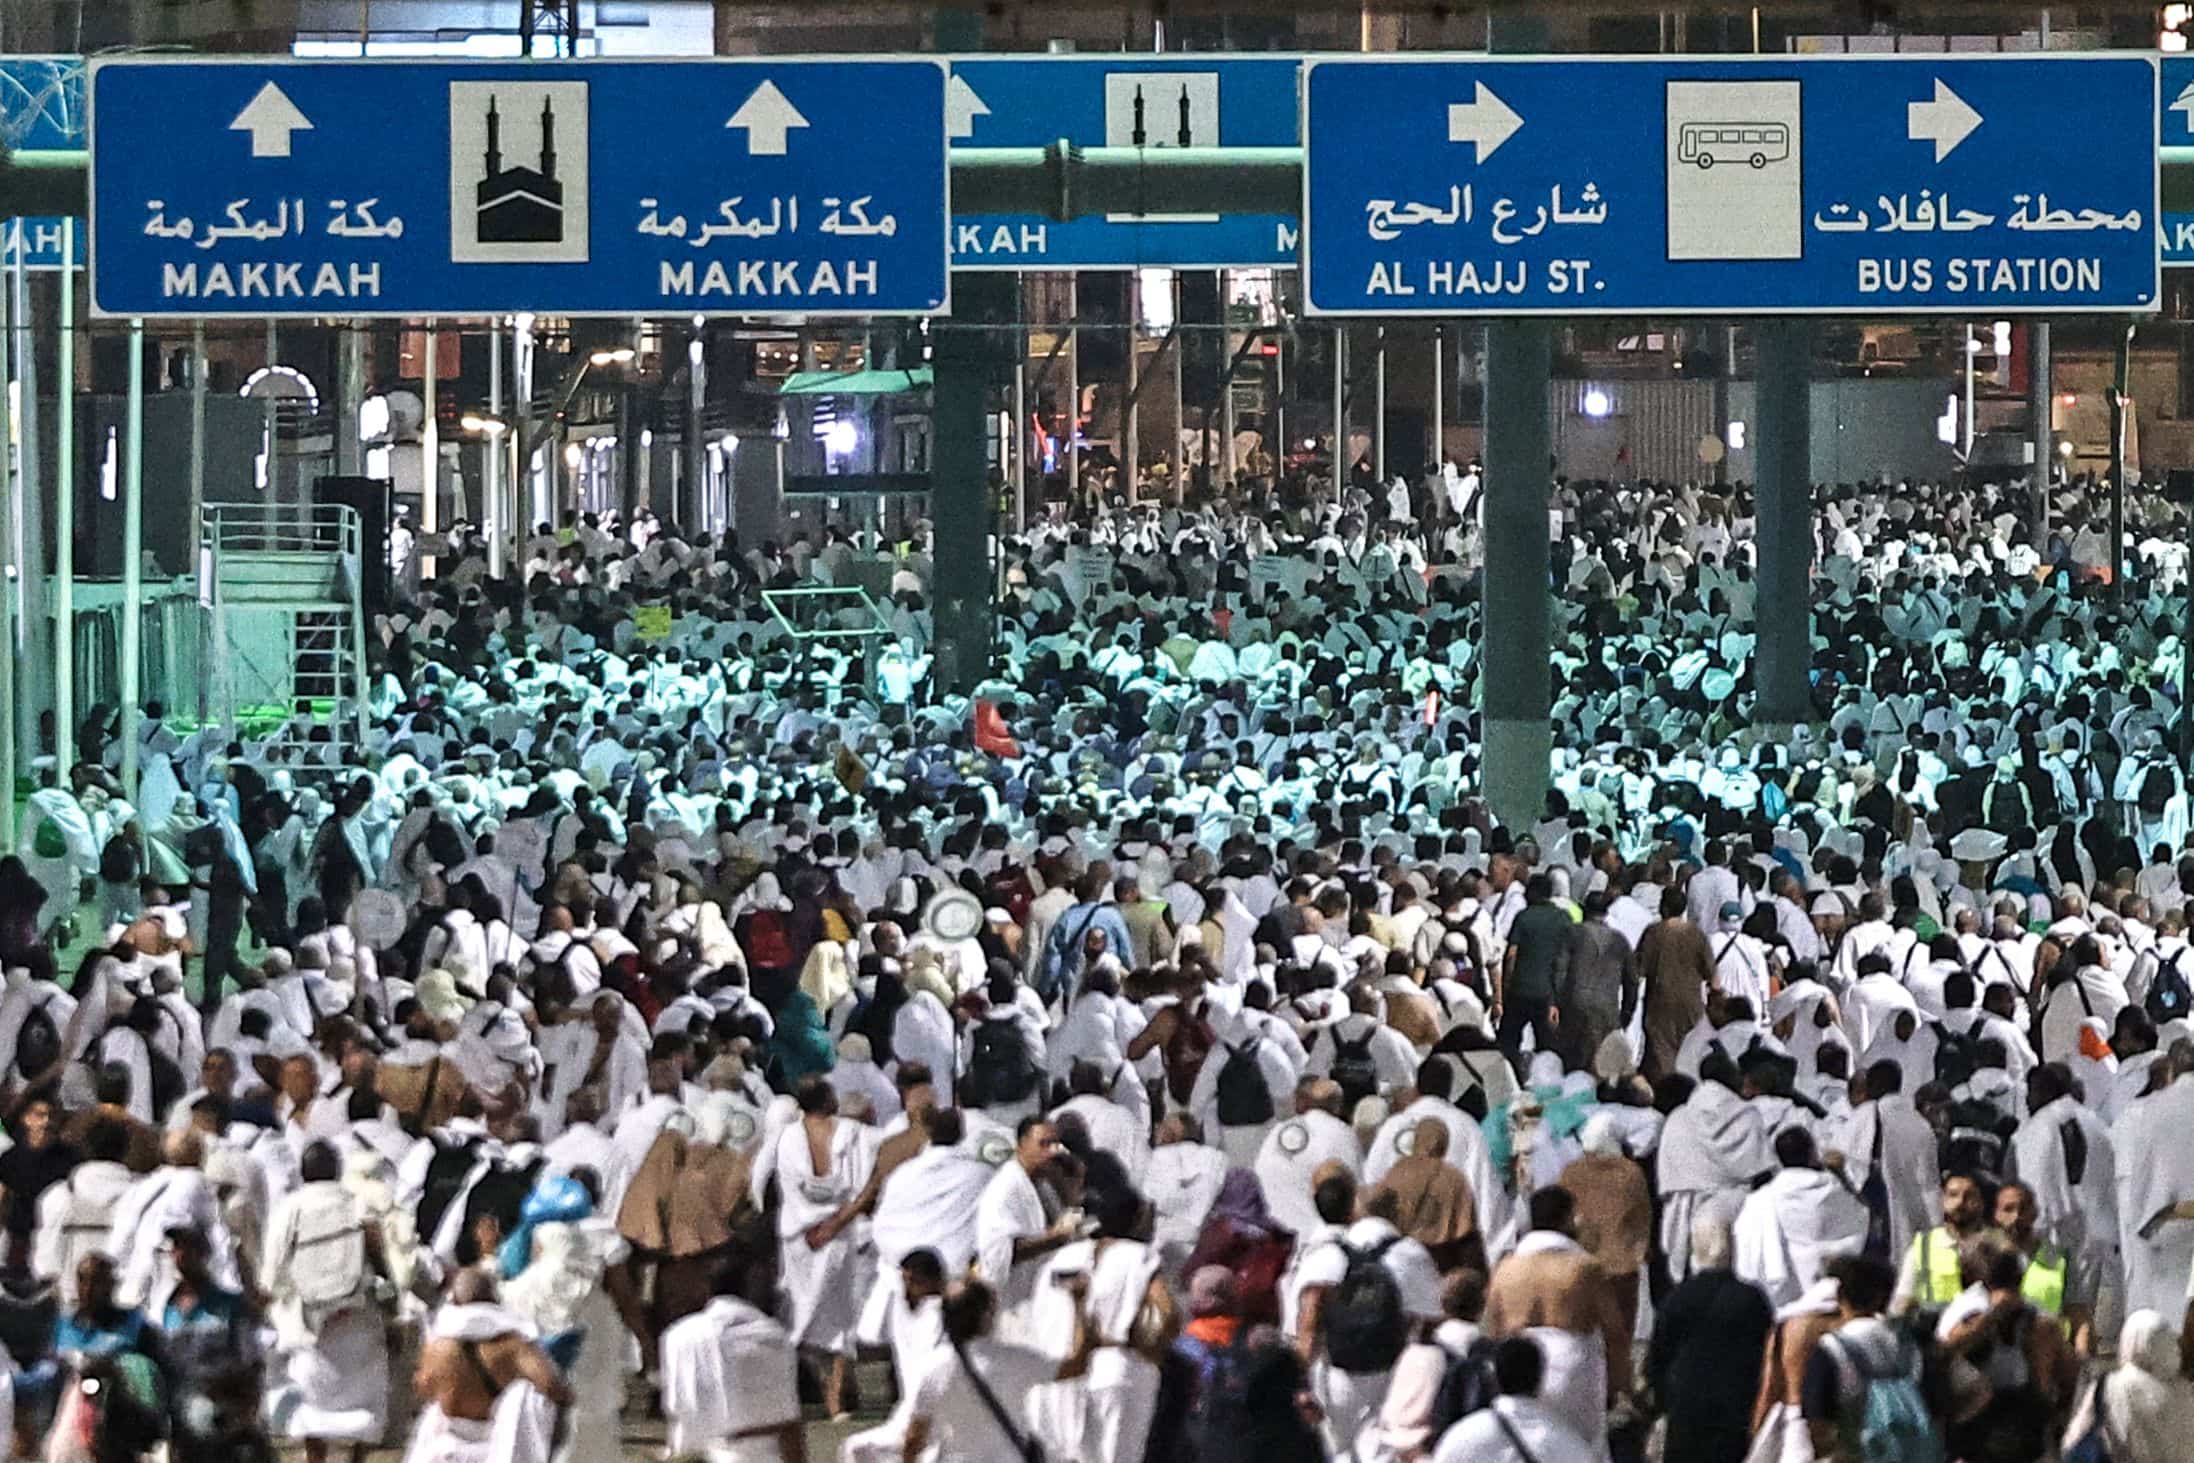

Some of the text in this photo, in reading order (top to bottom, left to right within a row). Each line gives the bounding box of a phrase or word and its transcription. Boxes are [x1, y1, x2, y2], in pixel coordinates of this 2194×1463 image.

[143, 198, 403, 249] مكة المكرمة
[637, 195, 897, 247] مكة المكرمة
[1365, 182, 1607, 244] شارع الحج
[1813, 189, 2142, 232] محطة حافلات
[950, 224, 1046, 253] KAH
[163, 262, 380, 297] MAKKAH
[659, 260, 877, 296] MAKKAH
[1366, 259, 1605, 295] AL HAJJ ST.
[1858, 257, 2100, 292] BUS STATION
